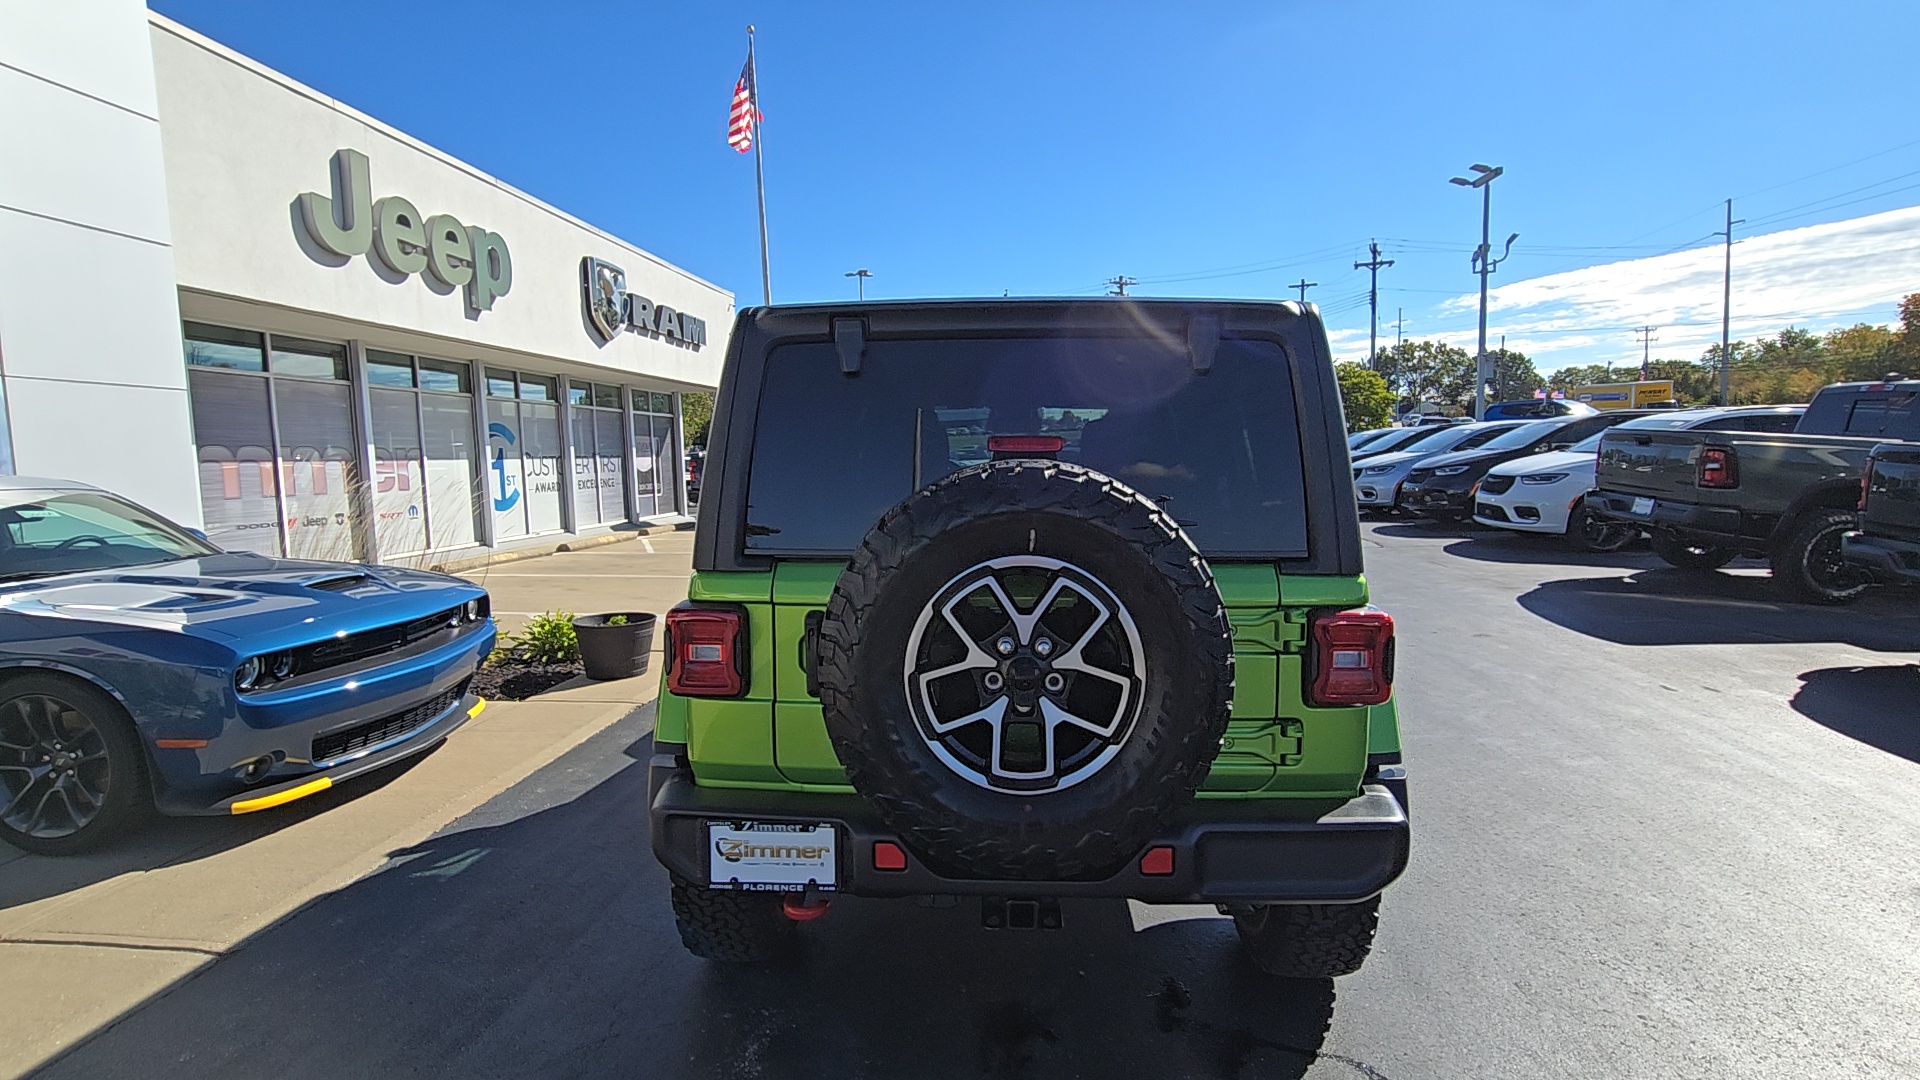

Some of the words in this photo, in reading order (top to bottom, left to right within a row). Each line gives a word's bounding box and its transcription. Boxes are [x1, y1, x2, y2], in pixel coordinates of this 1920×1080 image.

[292, 149, 512, 318] Jeep
[629, 293, 707, 350] RAM
[535, 481, 561, 494] AWARD
[578, 478, 615, 490] EXCELENCE
[302, 515, 328, 530] Jeep
[379, 511, 404, 520] SRT
[741, 821, 803, 832] Zimmer
[722, 840, 831, 859] Zimmer
[742, 883, 804, 892] FLORENCE
